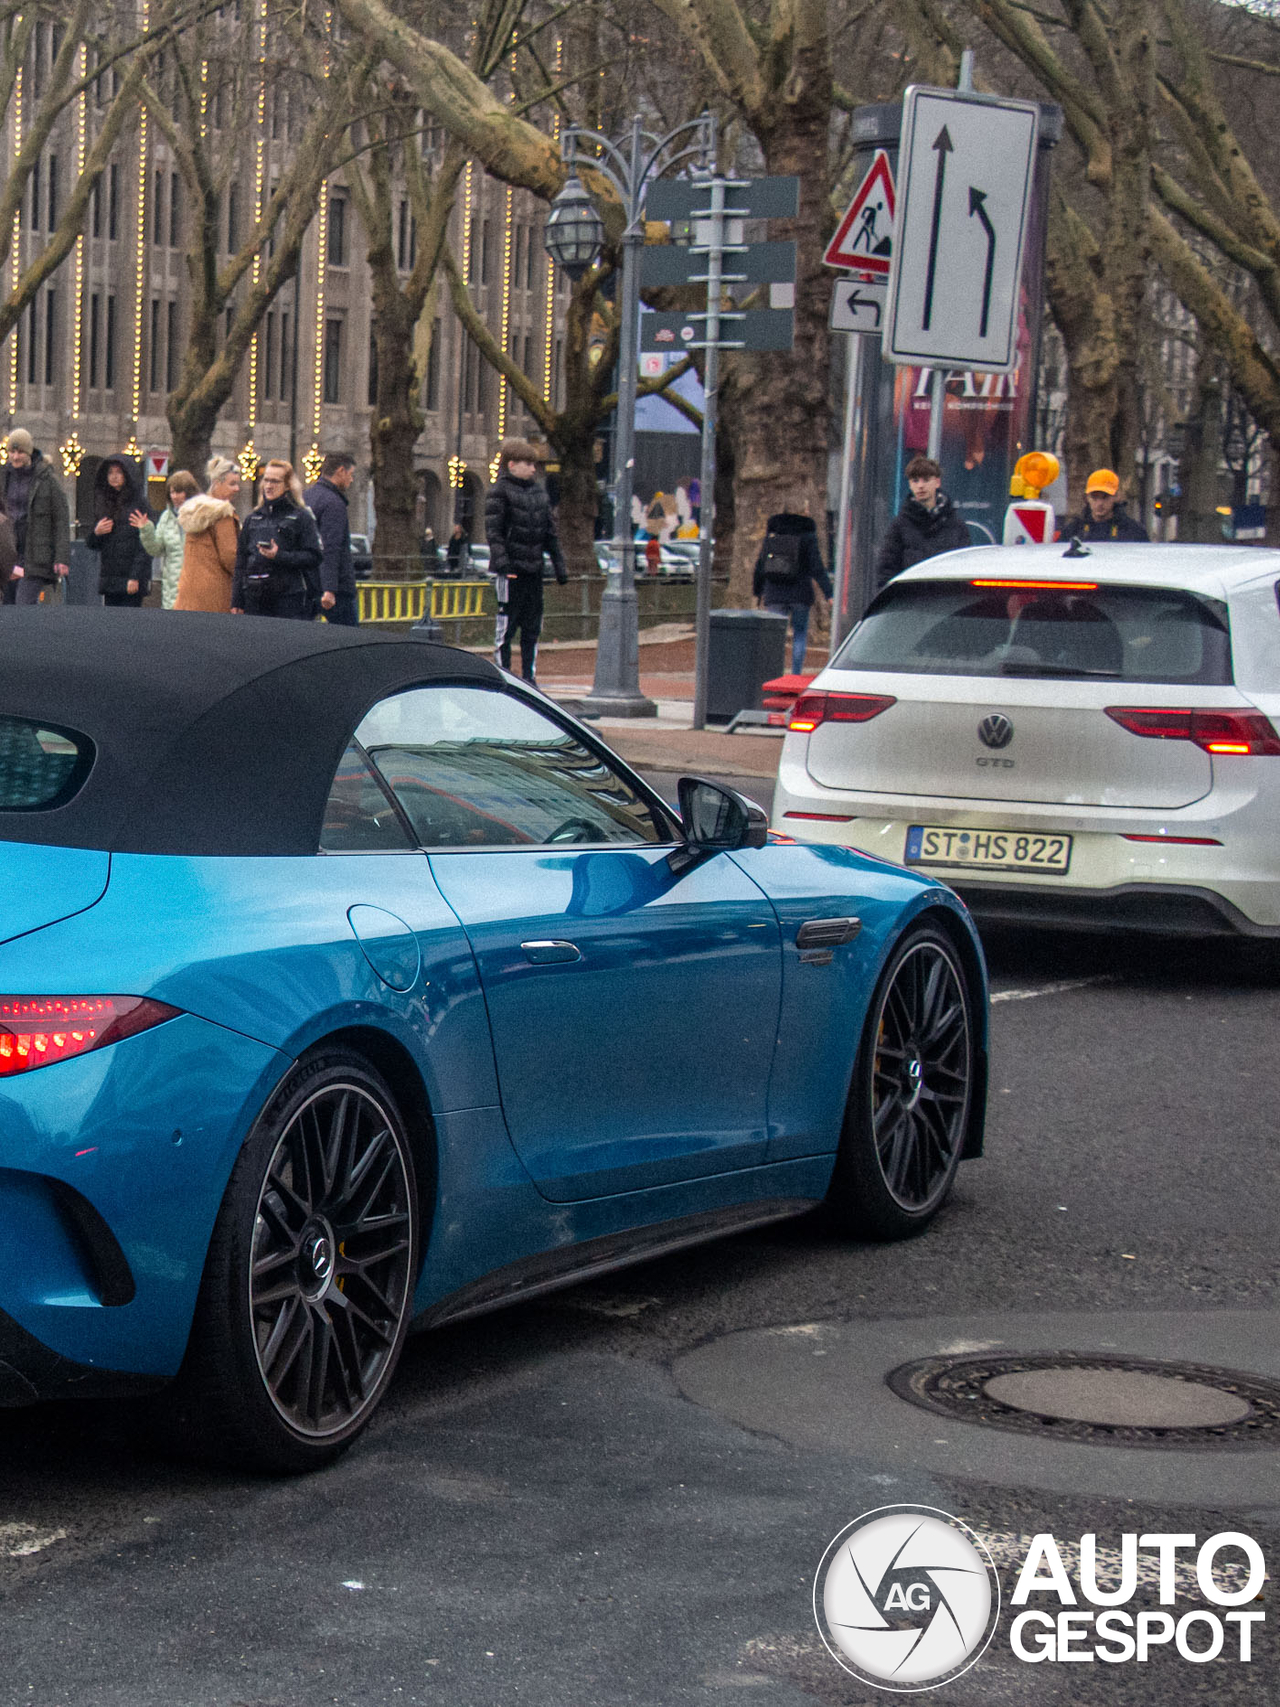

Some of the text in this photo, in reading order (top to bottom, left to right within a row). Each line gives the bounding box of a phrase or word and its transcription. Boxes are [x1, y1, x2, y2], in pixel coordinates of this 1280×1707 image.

[923, 832, 958, 857] ST
[973, 834, 1009, 859] HS
[1014, 837, 1064, 864] 822
